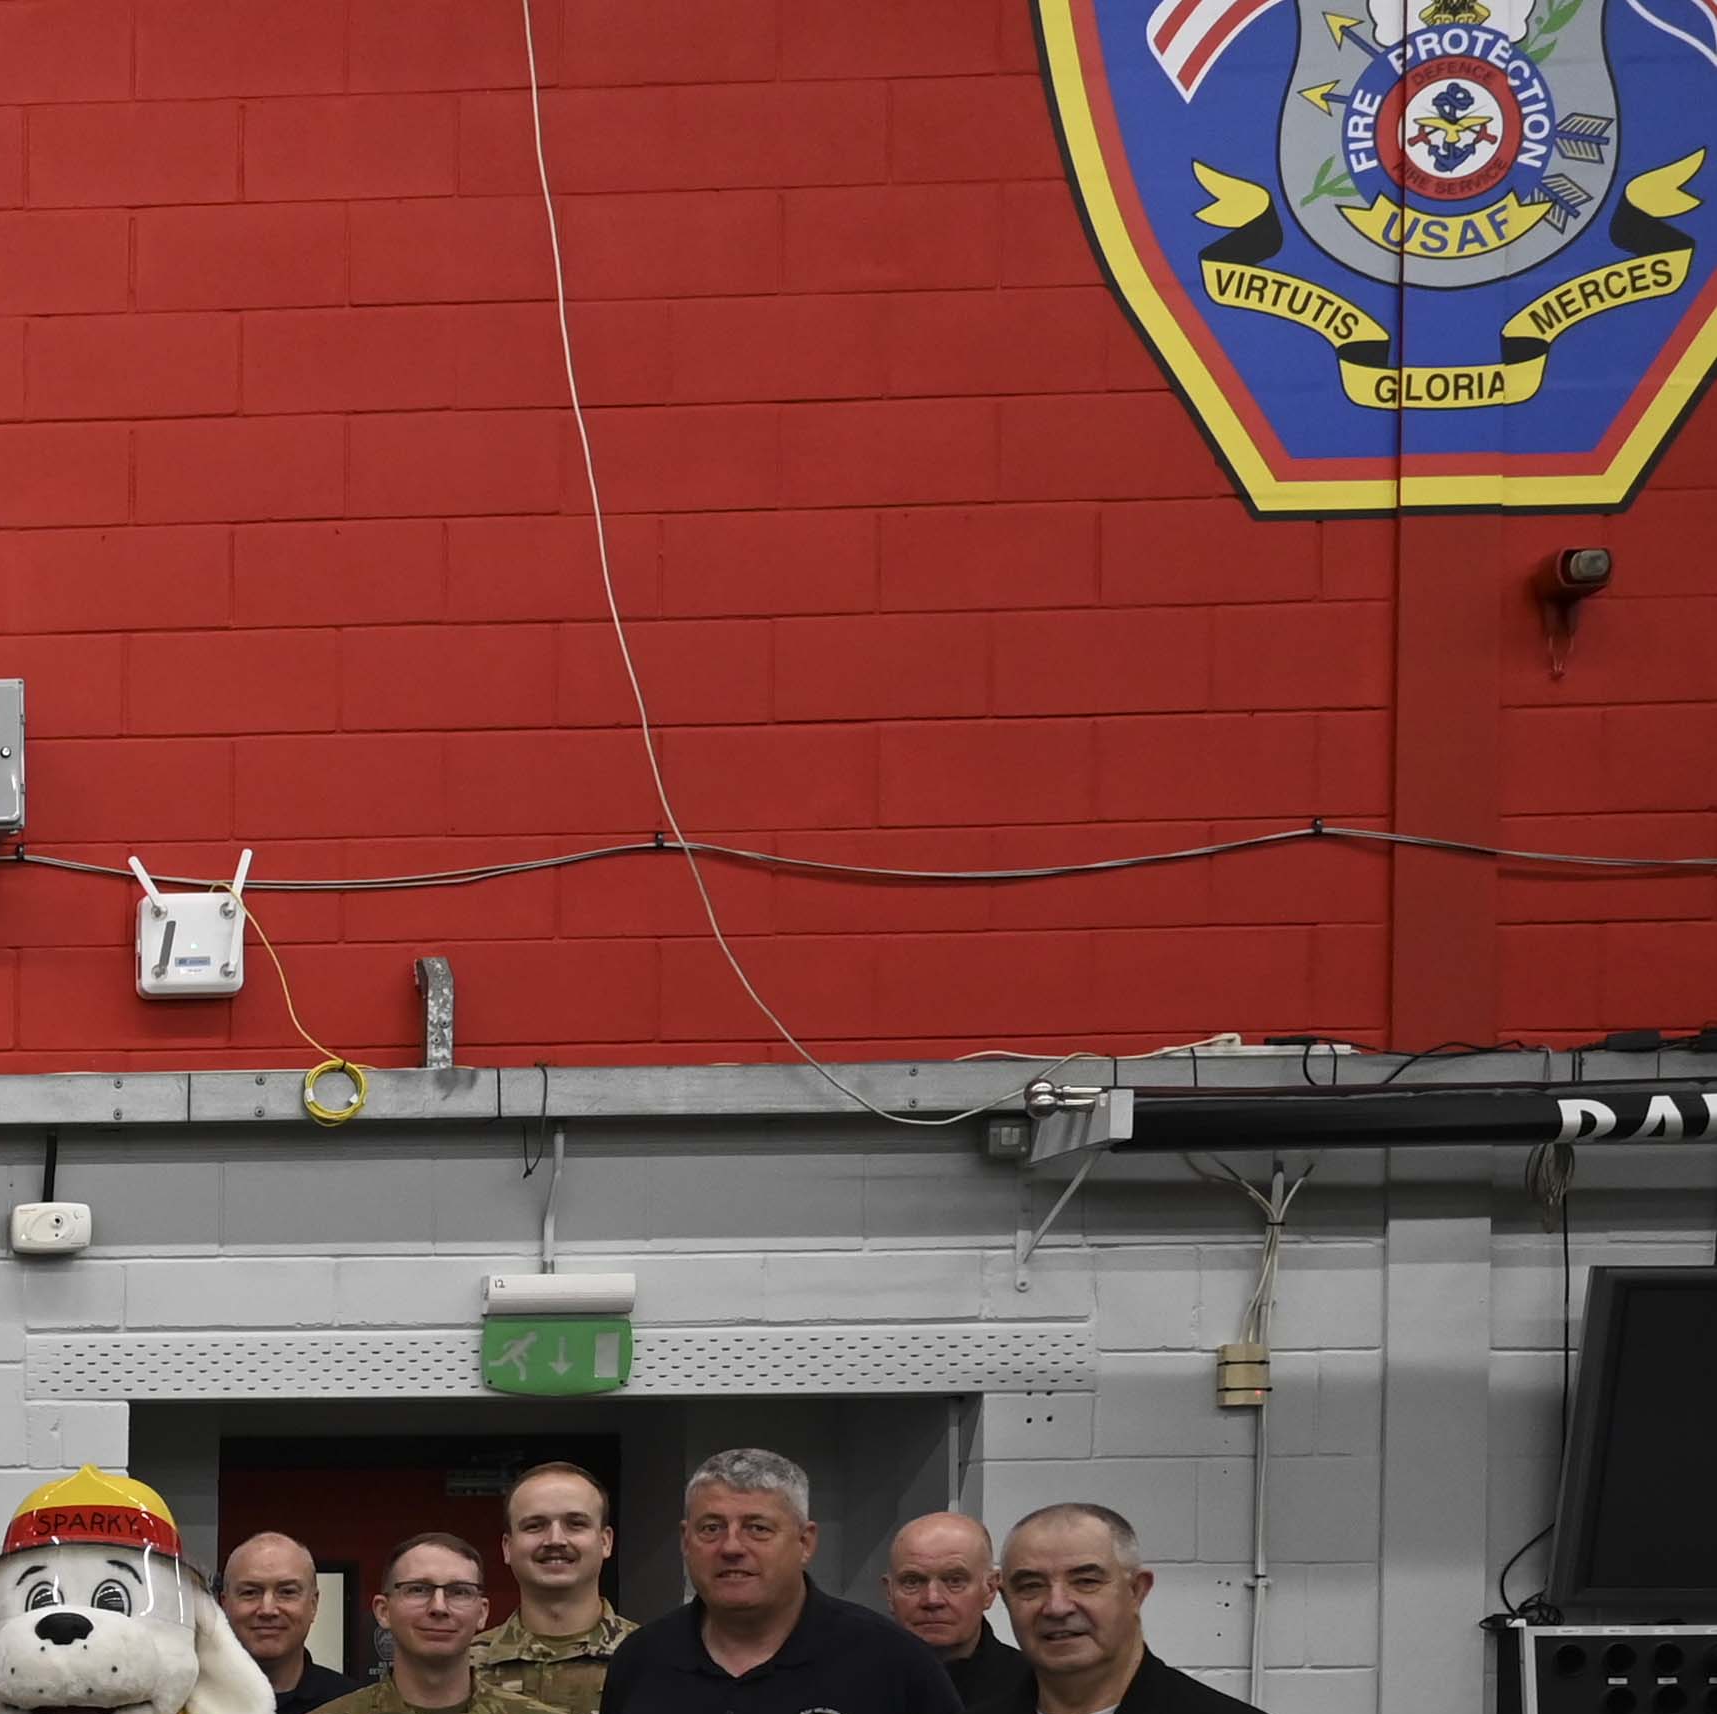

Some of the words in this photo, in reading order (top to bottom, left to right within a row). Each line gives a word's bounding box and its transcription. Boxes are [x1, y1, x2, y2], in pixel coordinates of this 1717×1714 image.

[1412, 61, 1497, 85] DEFENCE
[1387, 28, 1550, 168] PROTECTION
[1347, 88, 1382, 173] FIRE
[1434, 159, 1508, 195] SERVICE
[1382, 205, 1510, 254] USAF
[1214, 267, 1360, 340] VIRTUTIS
[1528, 259, 1673, 335] MERCES
[1374, 369, 1505, 404] GLORIA
[35, 1512, 138, 1535] SPARKY
